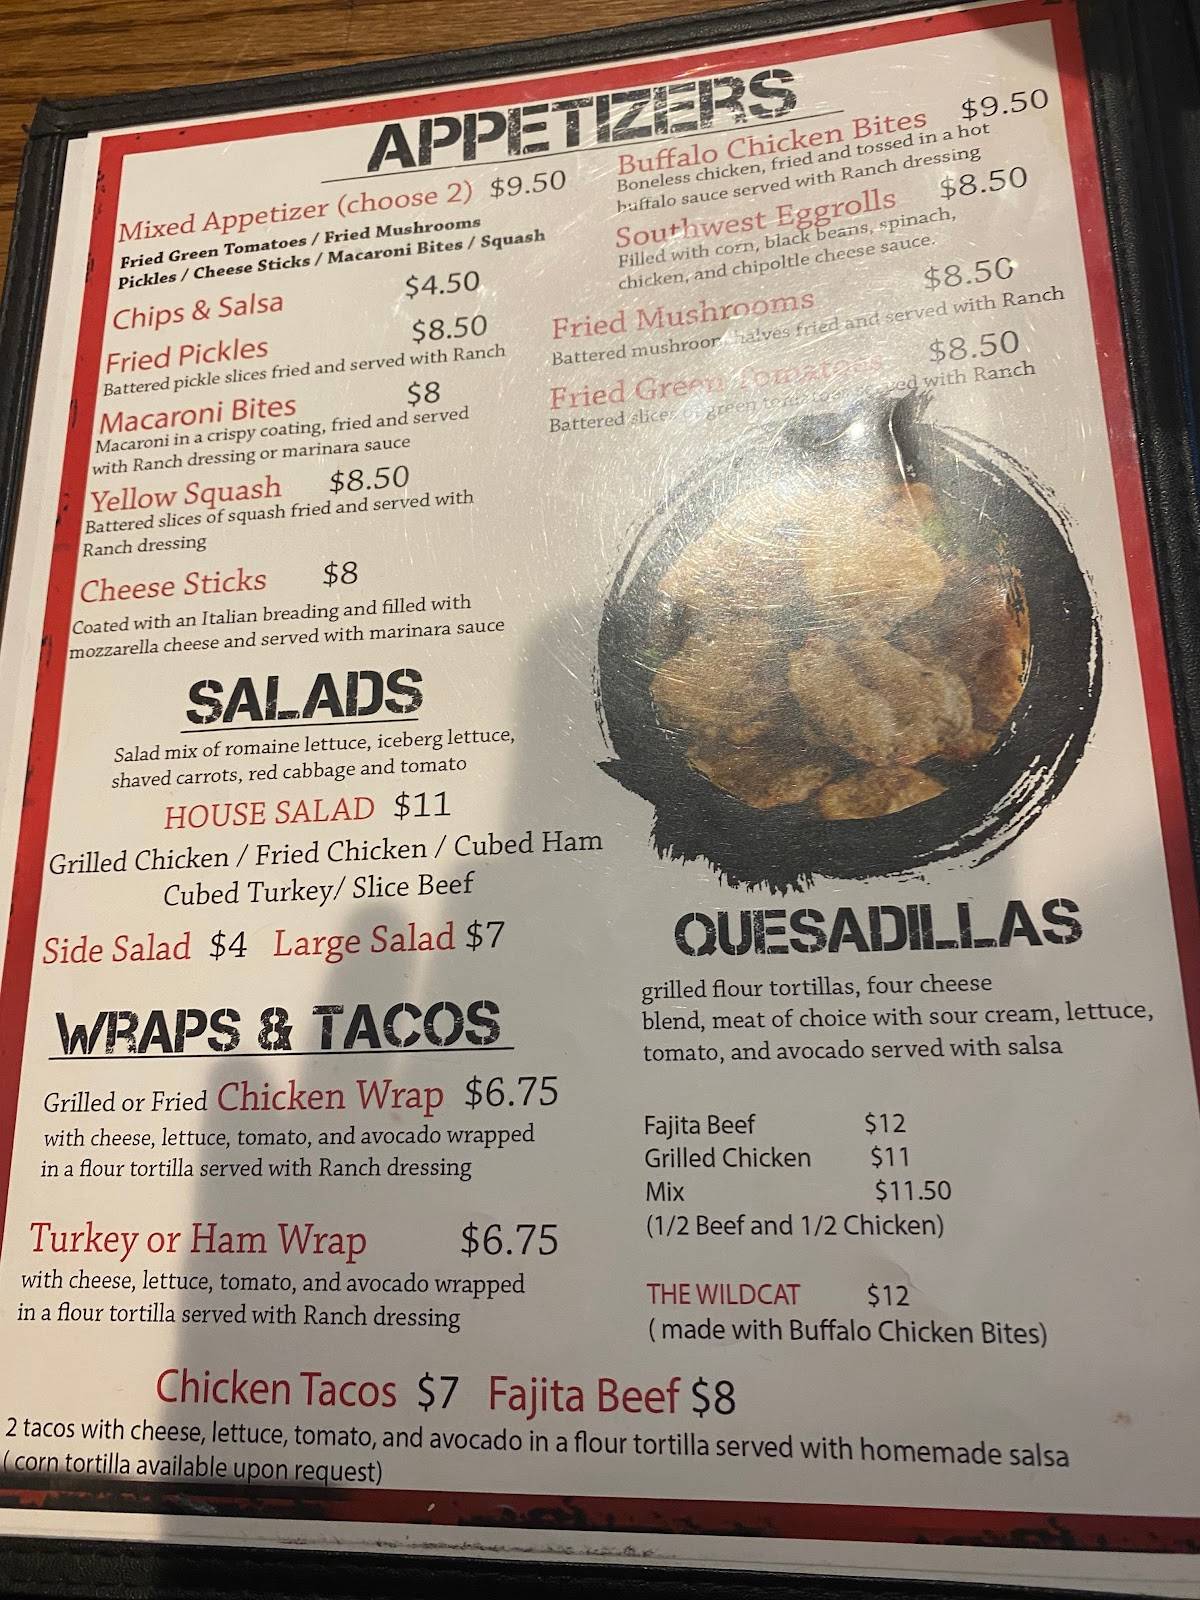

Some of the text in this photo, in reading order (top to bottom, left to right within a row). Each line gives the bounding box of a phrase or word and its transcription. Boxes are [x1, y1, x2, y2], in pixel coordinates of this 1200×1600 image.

[368, 69, 797, 172] APPETIZERS
[618, 88, 1048, 176] Buffalo Chicken Bites $9.50
[617, 123, 990, 193] Boneless chicken, fried and tossed in a hot
[617, 147, 981, 213] buffalo sauce served with Ranch dressing
[117, 170, 566, 244] Mixed Appetizer (choose 2) $9.50
[616, 166, 1027, 249] Southwest Eggrolls $8.50
[121, 218, 480, 270] Fried Green Tomatoes / Fried Mushrooms
[619, 236, 935, 290] chicken, and chipoltle cheese sauce.
[113, 270, 479, 332] Chips & Salsa $4.50
[553, 256, 1013, 340] Fried Mushrooms $8.50
[103, 342, 505, 397] Battered pickle slices fried and served with Ranch
[107, 314, 487, 375] Fried Pickles $8.50
[929, 329, 1019, 365] $8.50
[100, 381, 440, 435] Macaroni Bites $8
[91, 464, 409, 513] Yellow Squash $8.50
[82, 536, 206, 559] Ranch dressing
[80, 560, 357, 604] Cheese Sticks $8
[72, 593, 471, 637] Coated with an Italian breading and filled with
[187, 668, 423, 725] SALADS
[114, 728, 514, 763] Salad mix of romaine lettuce, iceberg lettuce,
[164, 790, 450, 830] HOUSE SALAD $11
[164, 880, 239, 906] Cubed
[353, 874, 409, 899] Slice
[418, 870, 475, 896] Beef
[43, 919, 504, 964] Side Salad $4 Large Salad $7
[675, 898, 1082, 957] QUESADILLAS
[642, 972, 992, 1006] grilled flour tortillas, four cheese
[56, 999, 500, 1055] WRAPS & TACOS
[44, 1074, 557, 1118] Grilled or Fried Chicken Wrap $6.75
[645, 1111, 906, 1141] Fajita Beef $12
[645, 1144, 908, 1169] Grilled Chicken $11
[647, 1179, 951, 1204] Mix $11.50
[30, 1220, 557, 1265] Turkey or Ham Wrap $6.75
[647, 1282, 909, 1308] THE WILDCAT $12
[157, 1368, 735, 1421] Chicken Tacos $7 Fajita Beef $8
[6, 1416, 1069, 1467] 2 tacos with cheese, lettuce, tomato, and avocado in a flour tortilla served with homemade salsa
